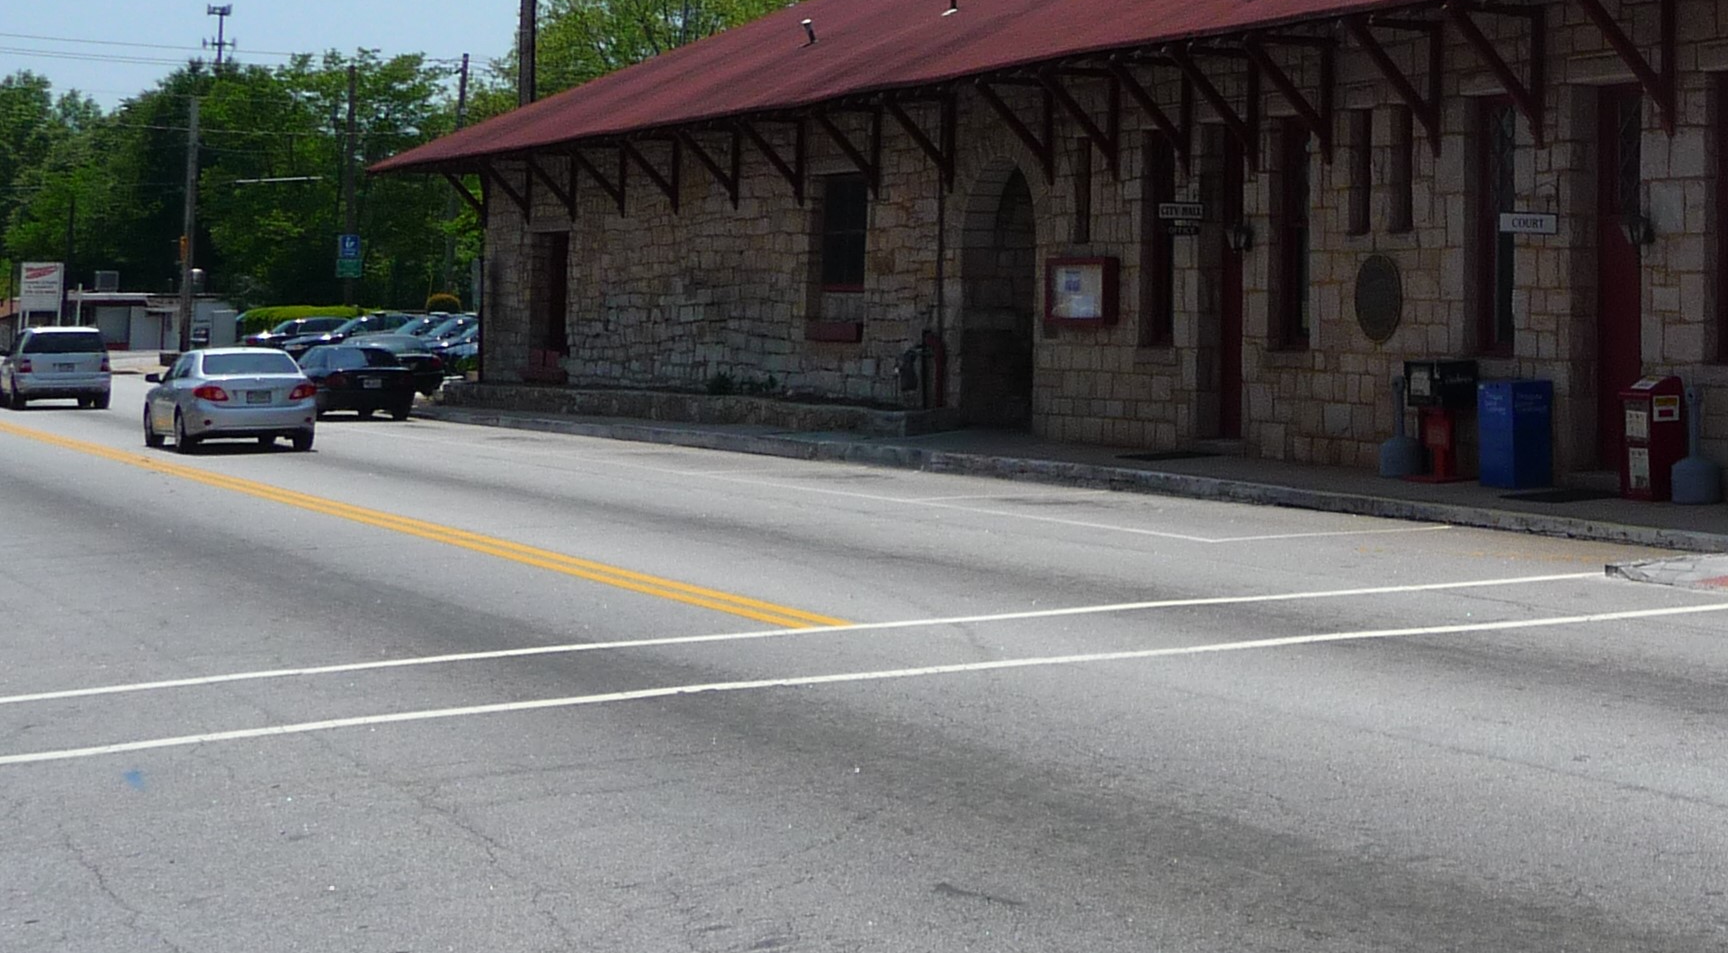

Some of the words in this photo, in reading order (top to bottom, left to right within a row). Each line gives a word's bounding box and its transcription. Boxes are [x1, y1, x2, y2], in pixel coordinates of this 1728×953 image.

[1161, 206, 1179, 216] CITY
[1182, 207, 1201, 216] HALL
[1511, 217, 1544, 228] COURT
